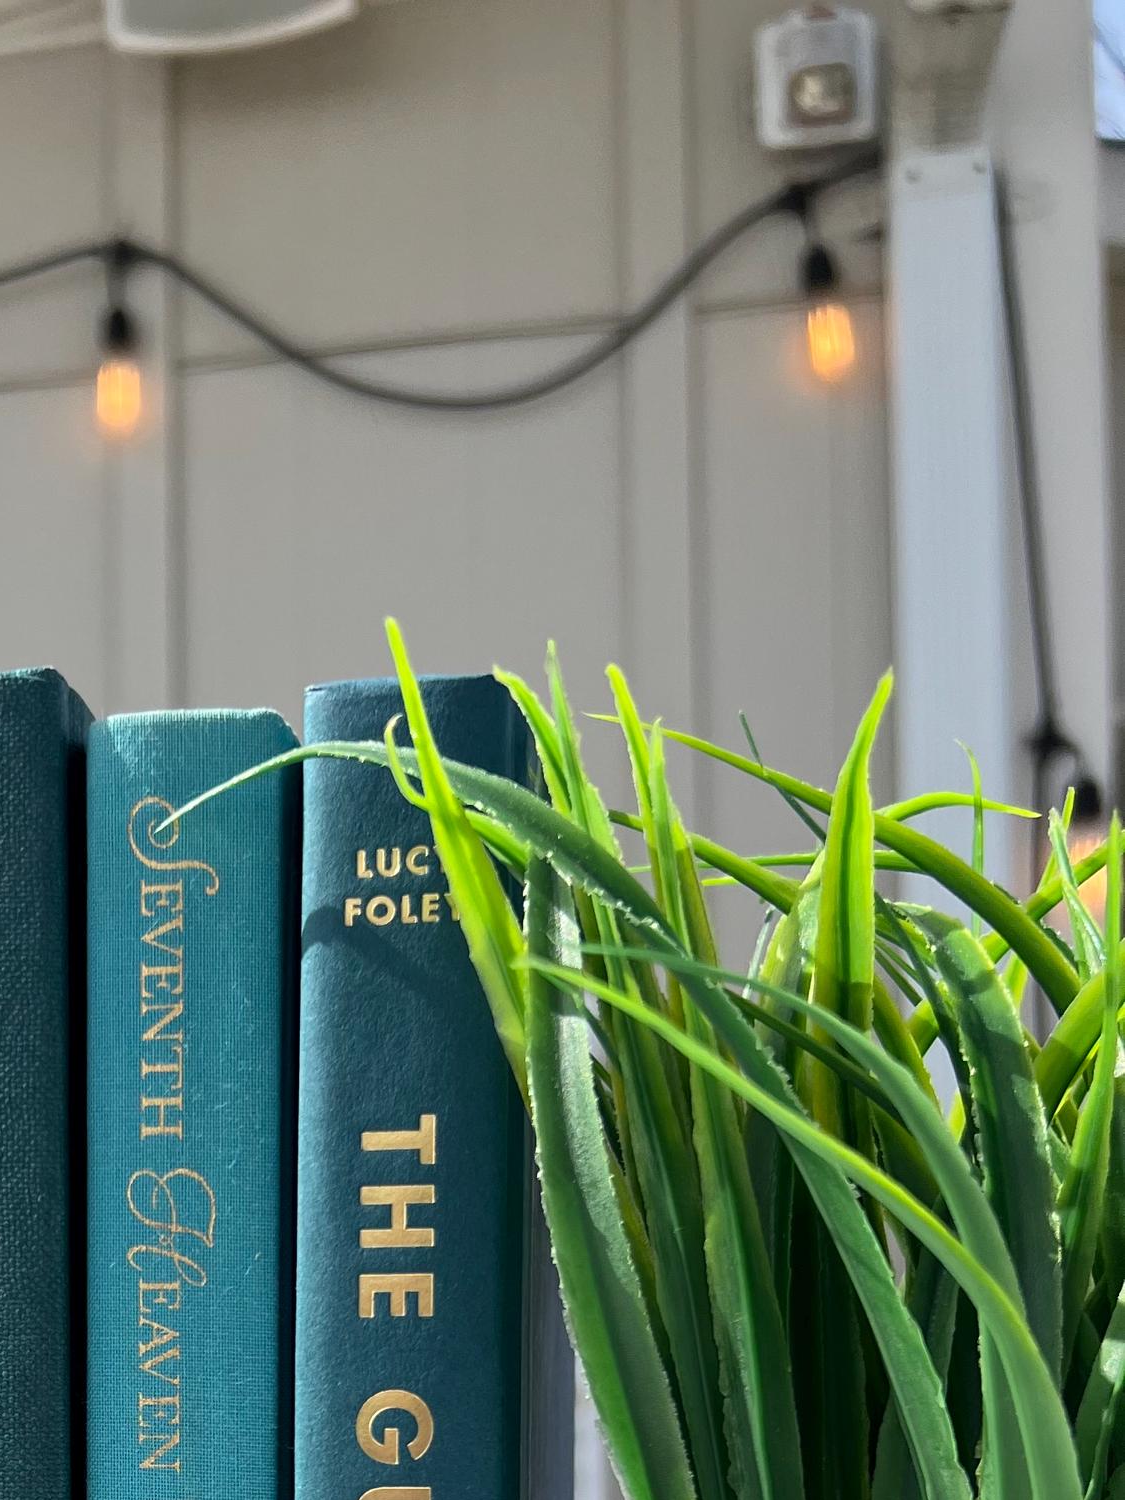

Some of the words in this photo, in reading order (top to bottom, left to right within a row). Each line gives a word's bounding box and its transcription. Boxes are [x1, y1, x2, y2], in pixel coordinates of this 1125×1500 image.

[126, 795, 219, 1142] SEVENTH
[356, 845, 446, 879] LUC
[126, 1167, 217, 1474] HEAVEN
[358, 1113, 437, 1320] THE
